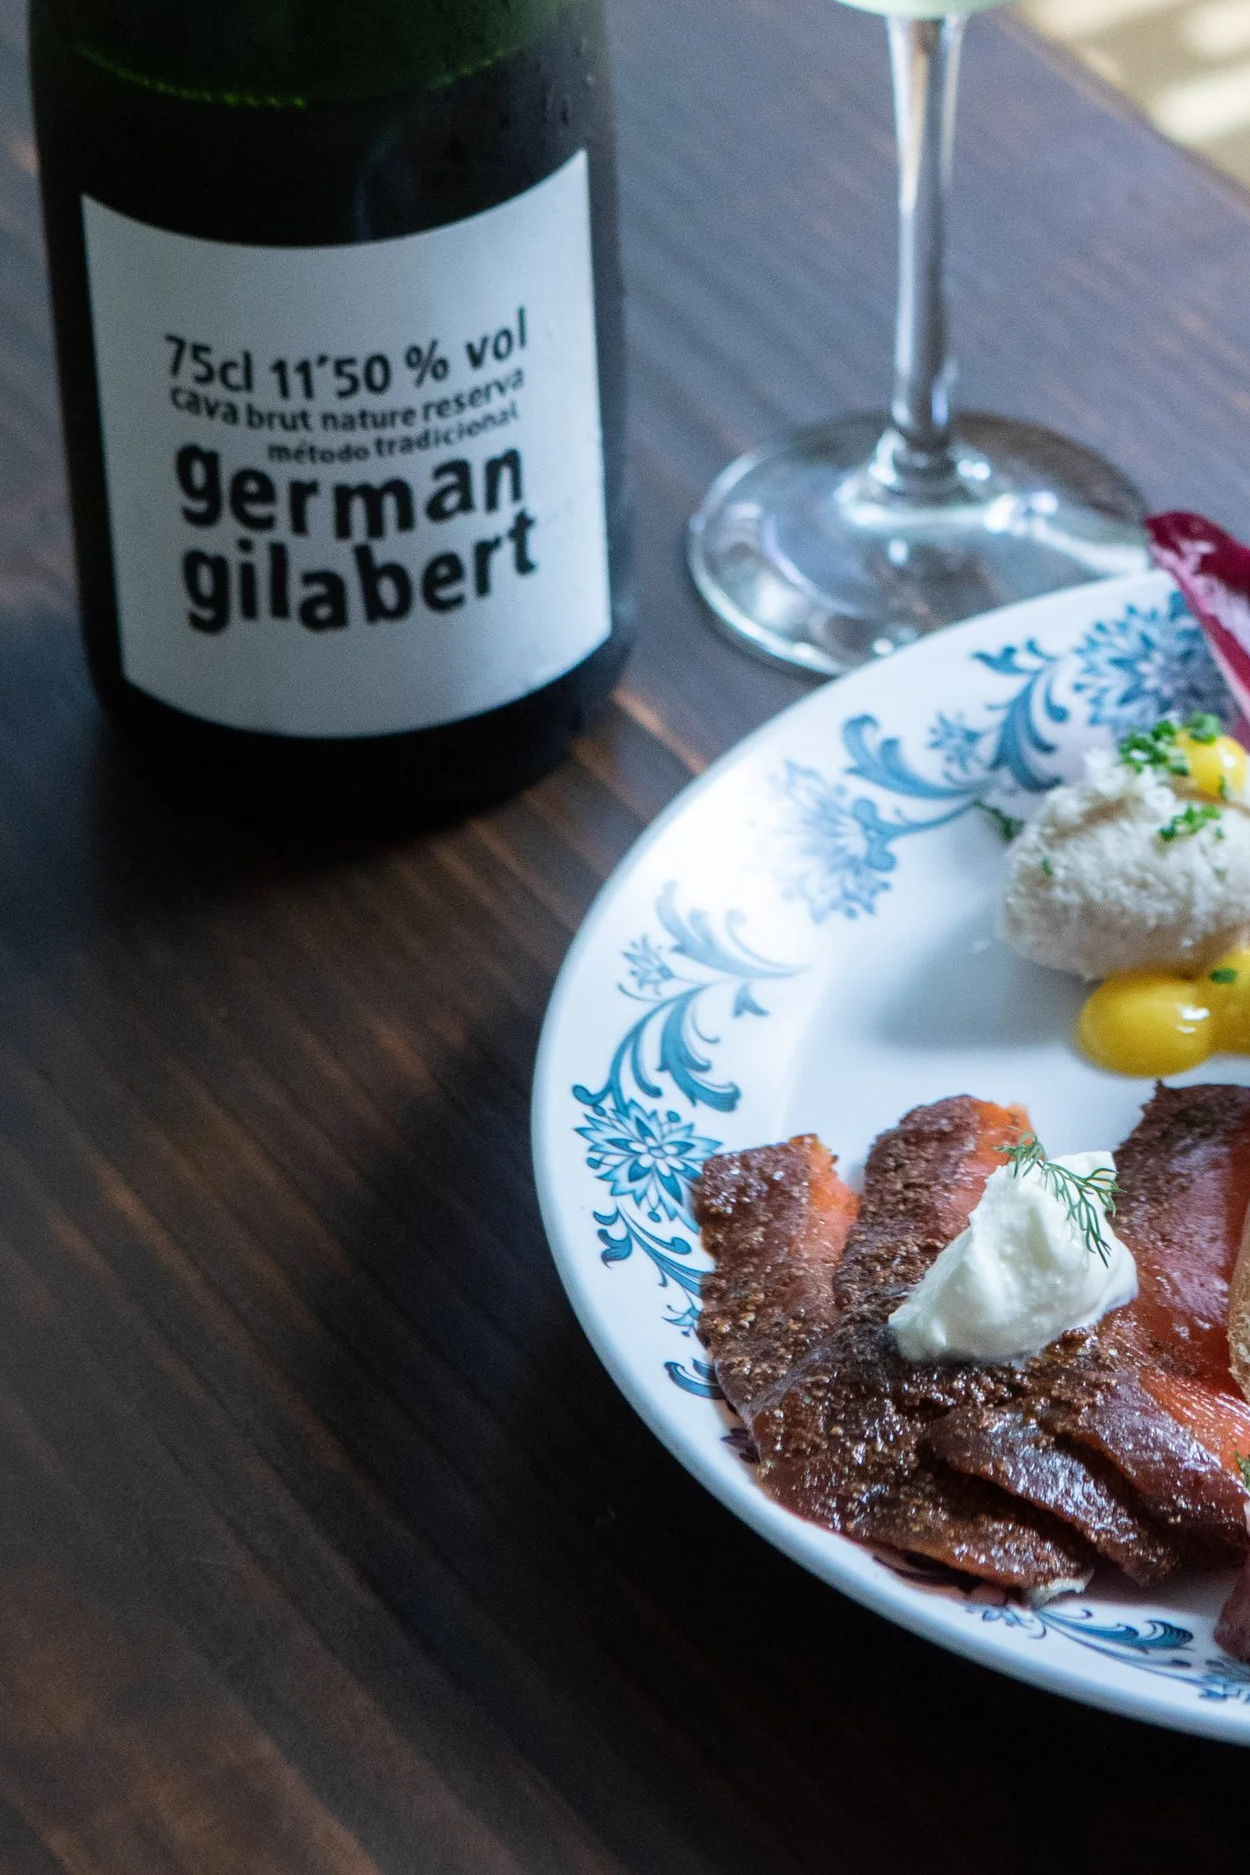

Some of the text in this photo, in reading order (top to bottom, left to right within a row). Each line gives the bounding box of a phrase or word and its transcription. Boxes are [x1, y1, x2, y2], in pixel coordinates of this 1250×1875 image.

[165, 334, 253, 393] 75cl
[405, 339, 450, 389] %
[465, 305, 527, 372] vol
[171, 367, 525, 433] cava brut nature reserva
[374, 399, 519, 459] tradicional
[175, 443, 524, 540] german
[182, 509, 539, 636] gilabert
